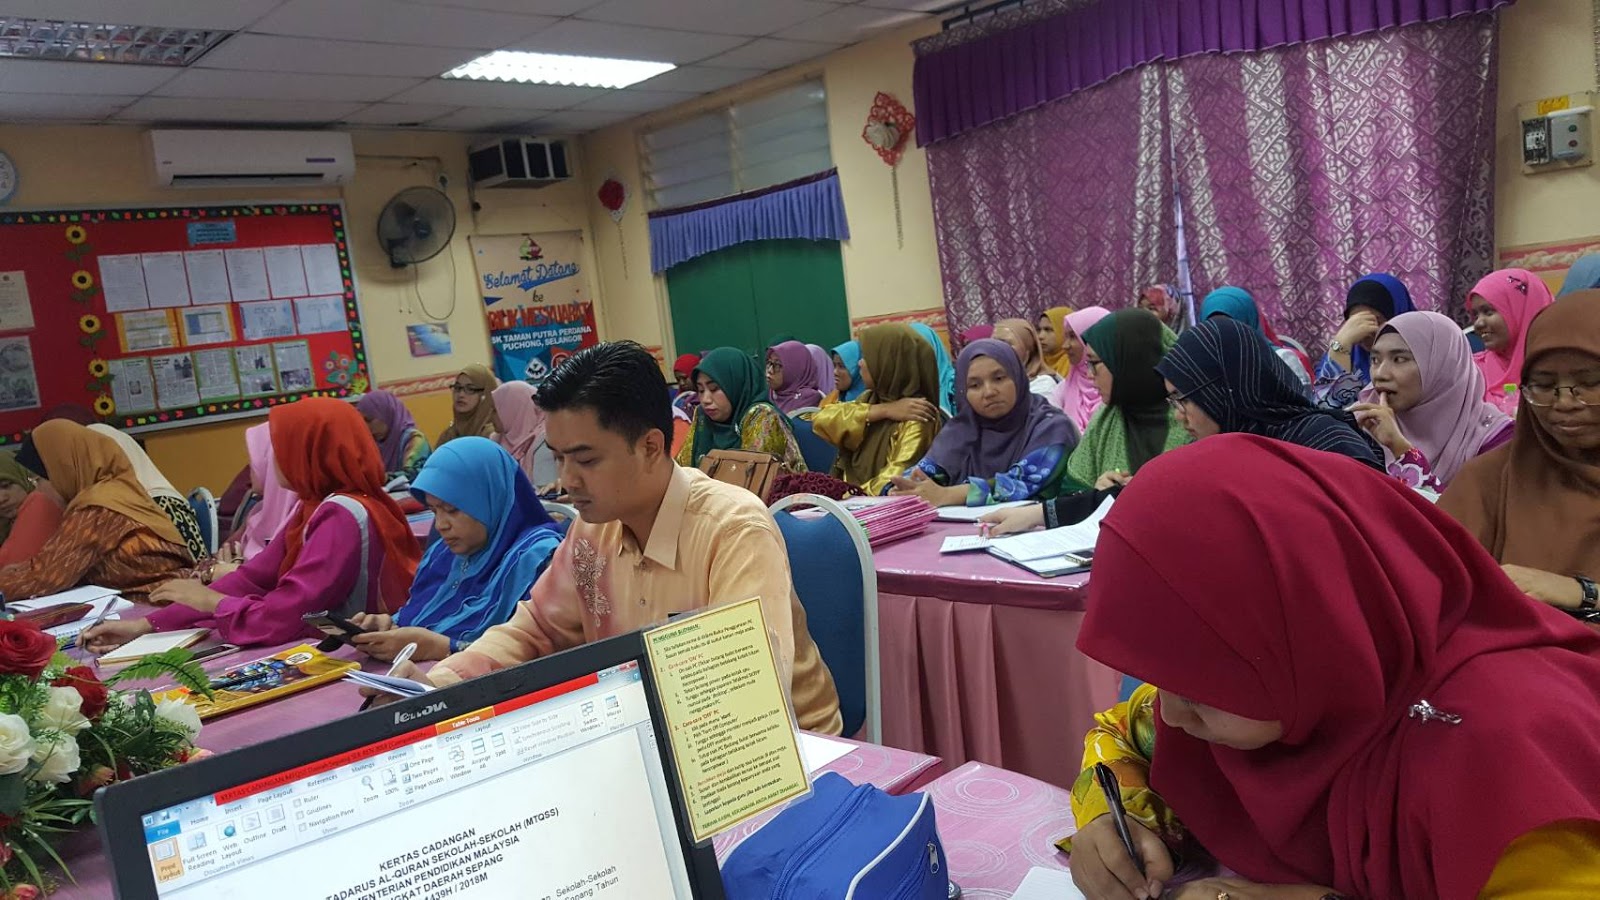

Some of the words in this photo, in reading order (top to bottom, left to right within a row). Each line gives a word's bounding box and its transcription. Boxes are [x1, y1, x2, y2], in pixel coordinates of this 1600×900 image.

[484, 266, 532, 289] Selamat
[533, 290, 544, 302] ke
[492, 335, 502, 344] SK
[504, 332, 531, 342] TAMAN
[532, 330, 558, 340] PUTRA
[559, 326, 592, 336] PERDANA
[503, 339, 544, 351] PUCHONG,
[545, 336, 582, 346] SELANGOR
[465, 716, 480, 724] Tools
[475, 723, 491, 732] Layout
[445, 733, 463, 742] Design
[388, 752, 407, 761] Review
[421, 756, 434, 764] Page
[351, 762, 375, 772] Mailings
[423, 767, 438, 775] Pages
[450, 770, 471, 779] Window
[307, 774, 338, 787] References
[258, 795, 272, 803] Page
[273, 788, 293, 798] Layout
[385, 787, 399, 795] 100%
[304, 795, 319, 803] Ruler
[363, 795, 379, 803] Zoom
[225, 804, 242, 814] Insert
[190, 816, 208, 825] Home
[309, 814, 340, 827] Navigation
[272, 825, 287, 835] Draft
[244, 833, 266, 844] Outline
[222, 843, 237, 851] Web
[379, 850, 420, 872] KERTAS
[422, 828, 476, 855] CADANGAN
[182, 856, 195, 865] Full
[196, 850, 217, 860] Screen
[221, 848, 242, 860] Layout
[326, 880, 376, 900] TADARUS
[379, 858, 430, 885] AL-QURAN
[432, 822, 522, 863] SEKOLAH-SEKOLAH
[524, 807, 559, 829] (MTQSS)
[188, 859, 215, 870] Reading
[204, 861, 236, 877] Document
[358, 878, 412, 900] ENTERIAN
[414, 854, 472, 883] PENDIDIKAN
[473, 835, 520, 859] MALAYSIA
[423, 870, 464, 892] DAERAH
[466, 854, 504, 875] SEPANG
[459, 872, 488, 891] 2018M
[556, 865, 617, 897] Sekolah-Sekolah
[595, 876, 618, 892] Tahun
